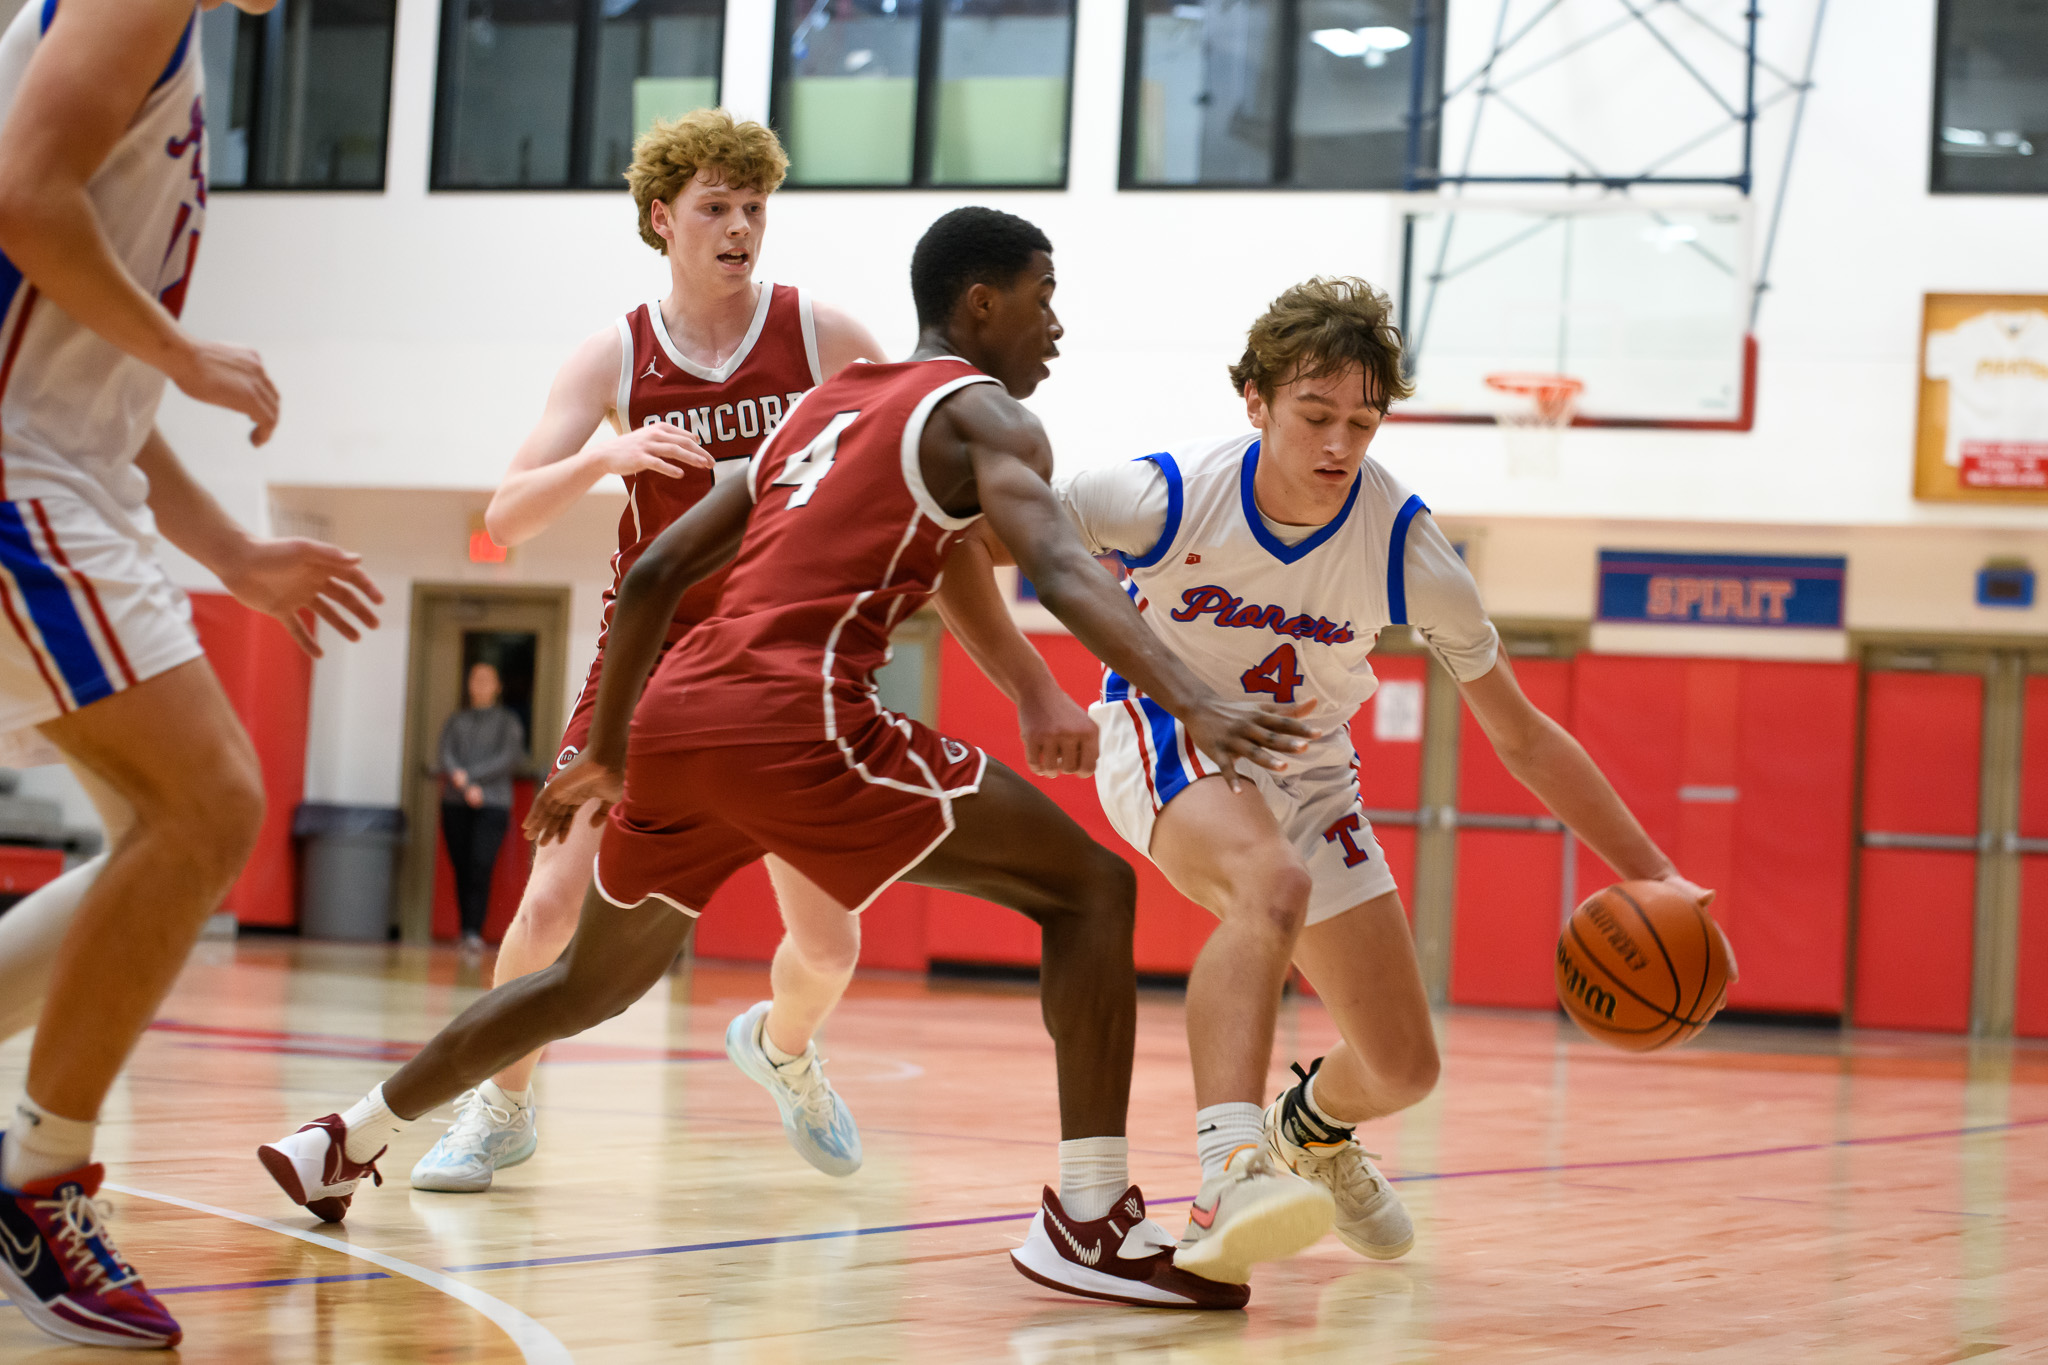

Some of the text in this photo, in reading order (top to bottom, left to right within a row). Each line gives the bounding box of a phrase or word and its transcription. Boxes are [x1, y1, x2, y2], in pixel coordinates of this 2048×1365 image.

[771, 409, 861, 511] 4
[1647, 577, 1793, 619] SPIRIT
[1240, 643, 1304, 703] 4
[1322, 812, 1369, 869] T
